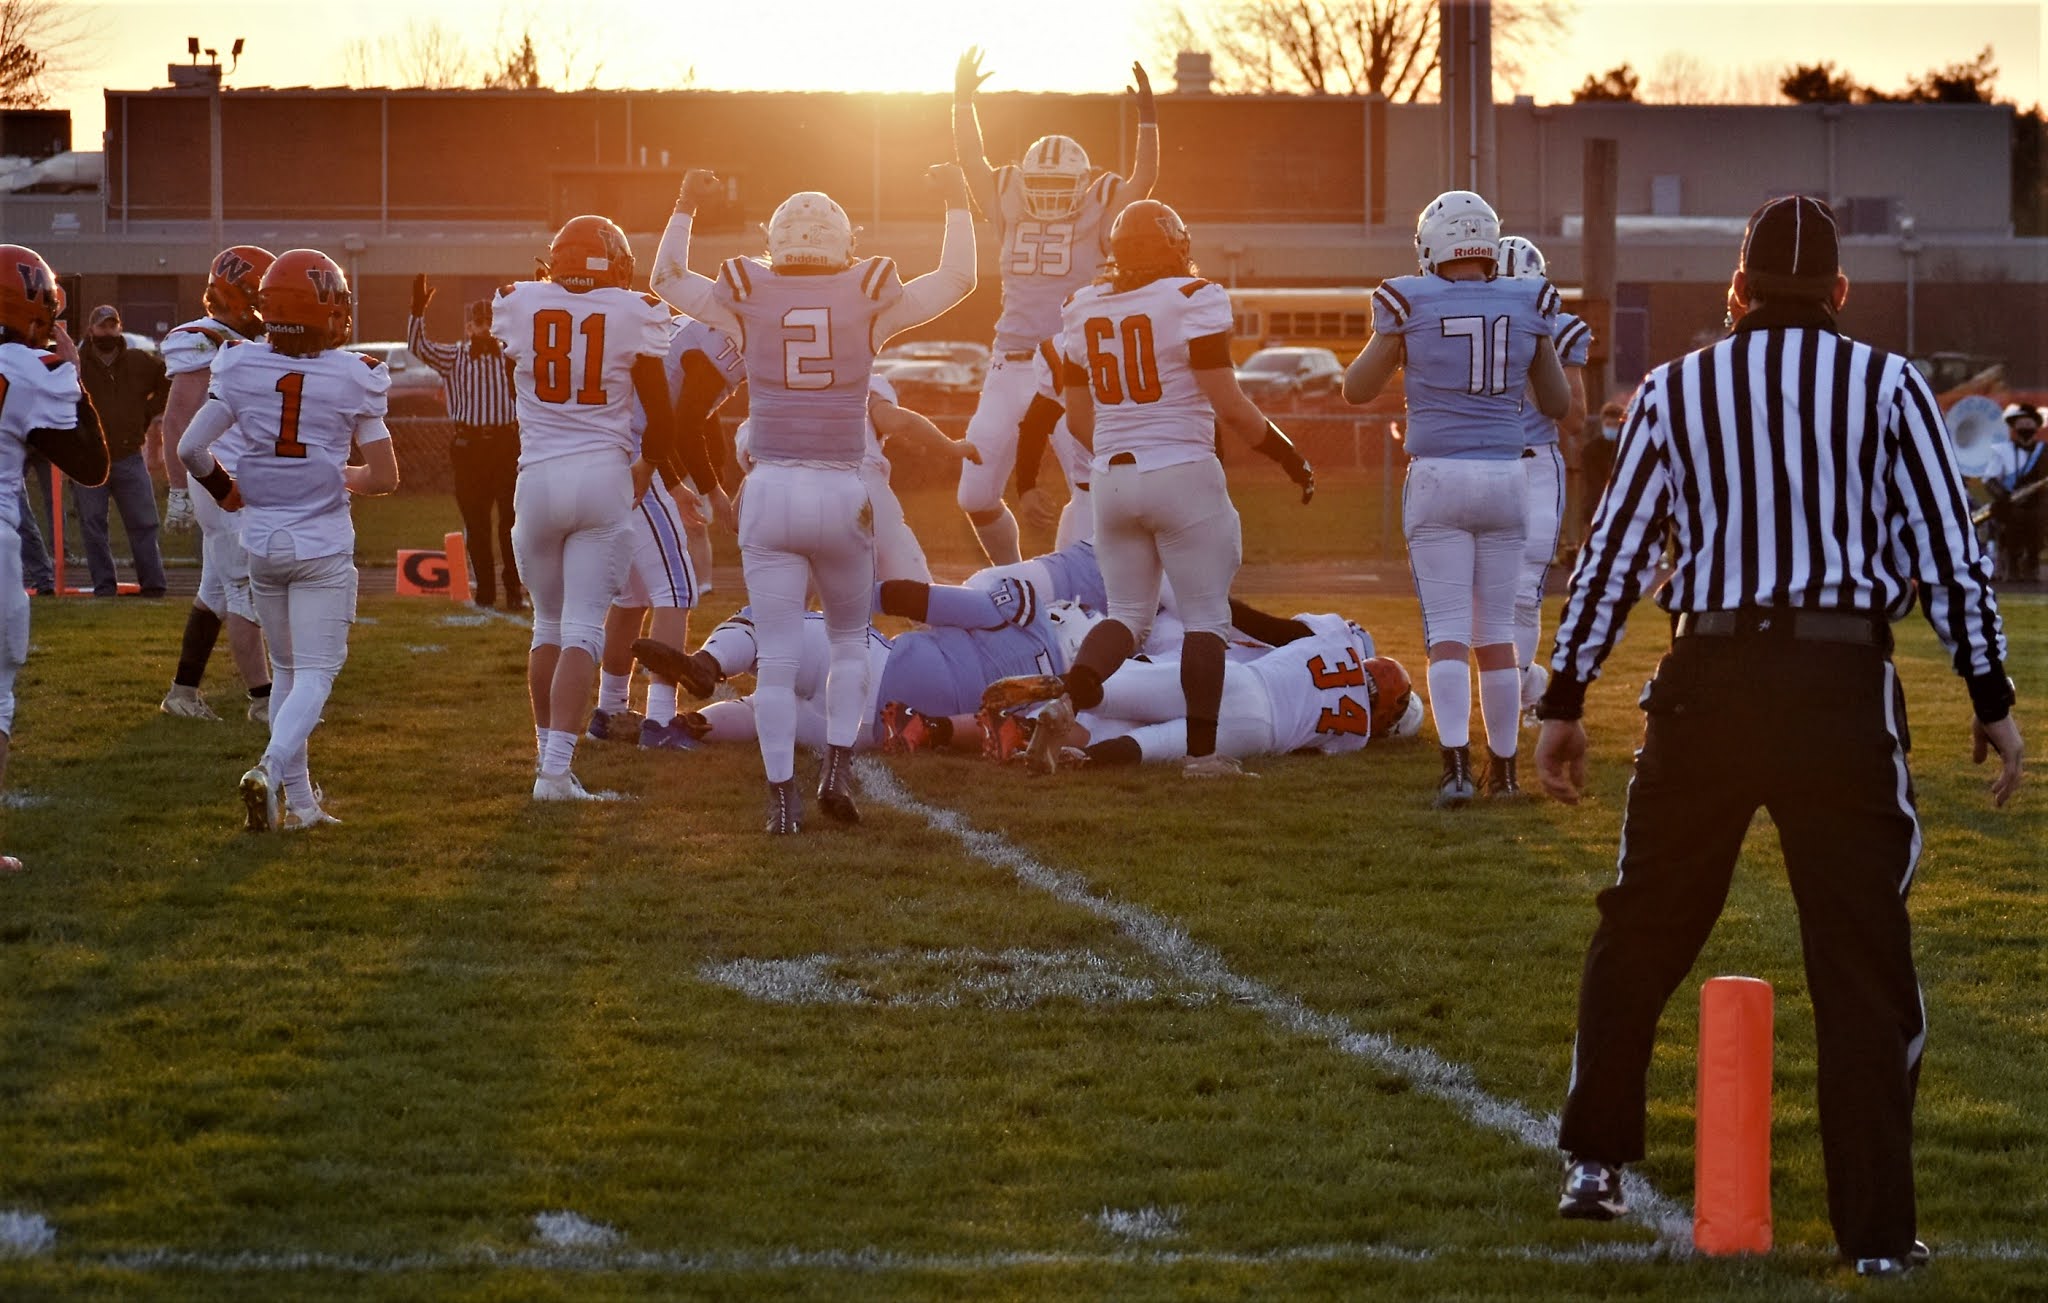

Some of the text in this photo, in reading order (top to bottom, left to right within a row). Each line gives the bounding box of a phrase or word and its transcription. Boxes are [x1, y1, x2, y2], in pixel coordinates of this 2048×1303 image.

[216, 250, 255, 285] W
[785, 253, 828, 266] Riddell
[1011, 221, 1076, 277] 53
[1454, 246, 1494, 257] Riddell
[16, 262, 54, 301] W
[306, 269, 347, 306] W
[558, 277, 594, 287] ddell
[265, 321, 305, 334] Riddell
[533, 309, 607, 406] 81
[781, 307, 835, 390] 2
[1083, 313, 1163, 404] 60
[1441, 314, 1511, 396] 71
[275, 372, 307, 458] 1
[404, 552, 451, 589] G
[1306, 646, 1369, 738] 34
